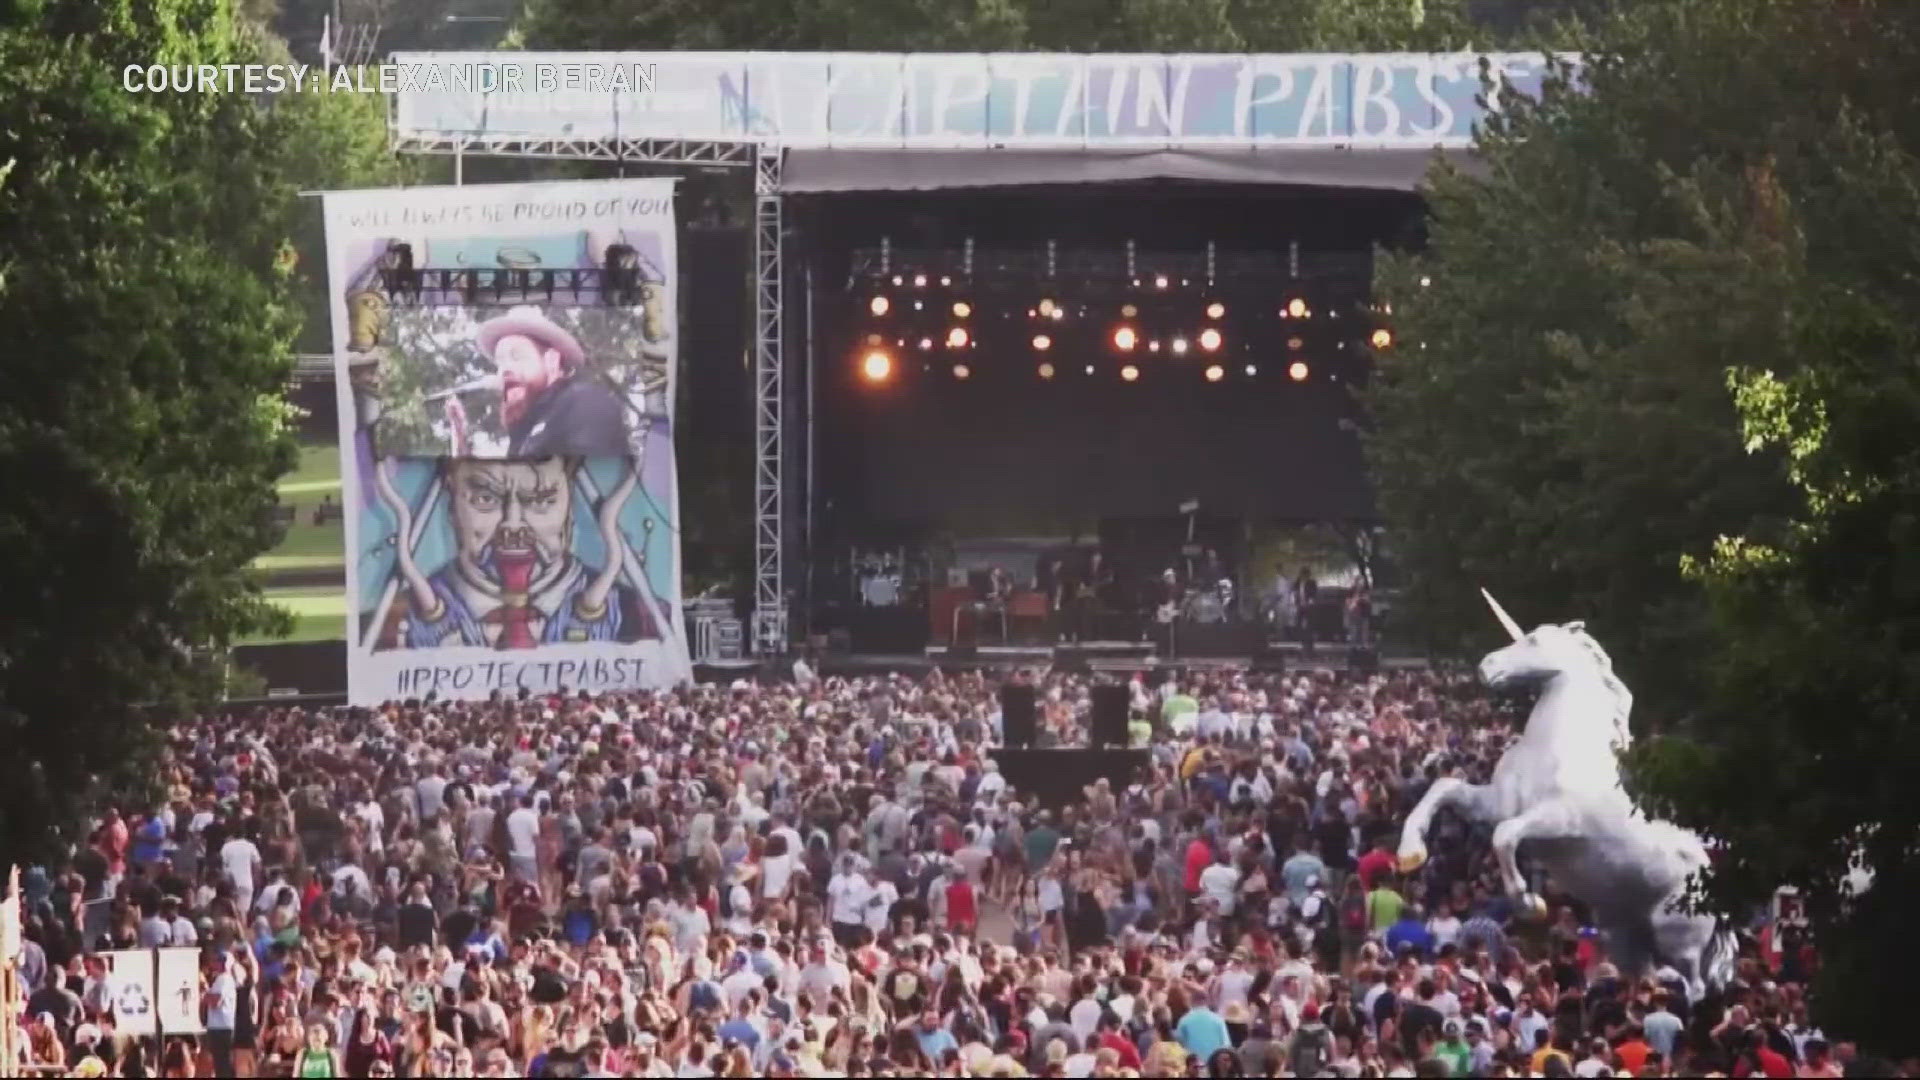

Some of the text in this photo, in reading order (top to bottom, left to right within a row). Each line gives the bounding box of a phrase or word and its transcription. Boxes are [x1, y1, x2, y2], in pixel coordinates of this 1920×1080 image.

[813, 56, 1191, 138] CAPTAIN
[512, 200, 586, 221] PROUD
[594, 198, 620, 218] OF
[626, 197, 671, 217] YOU
